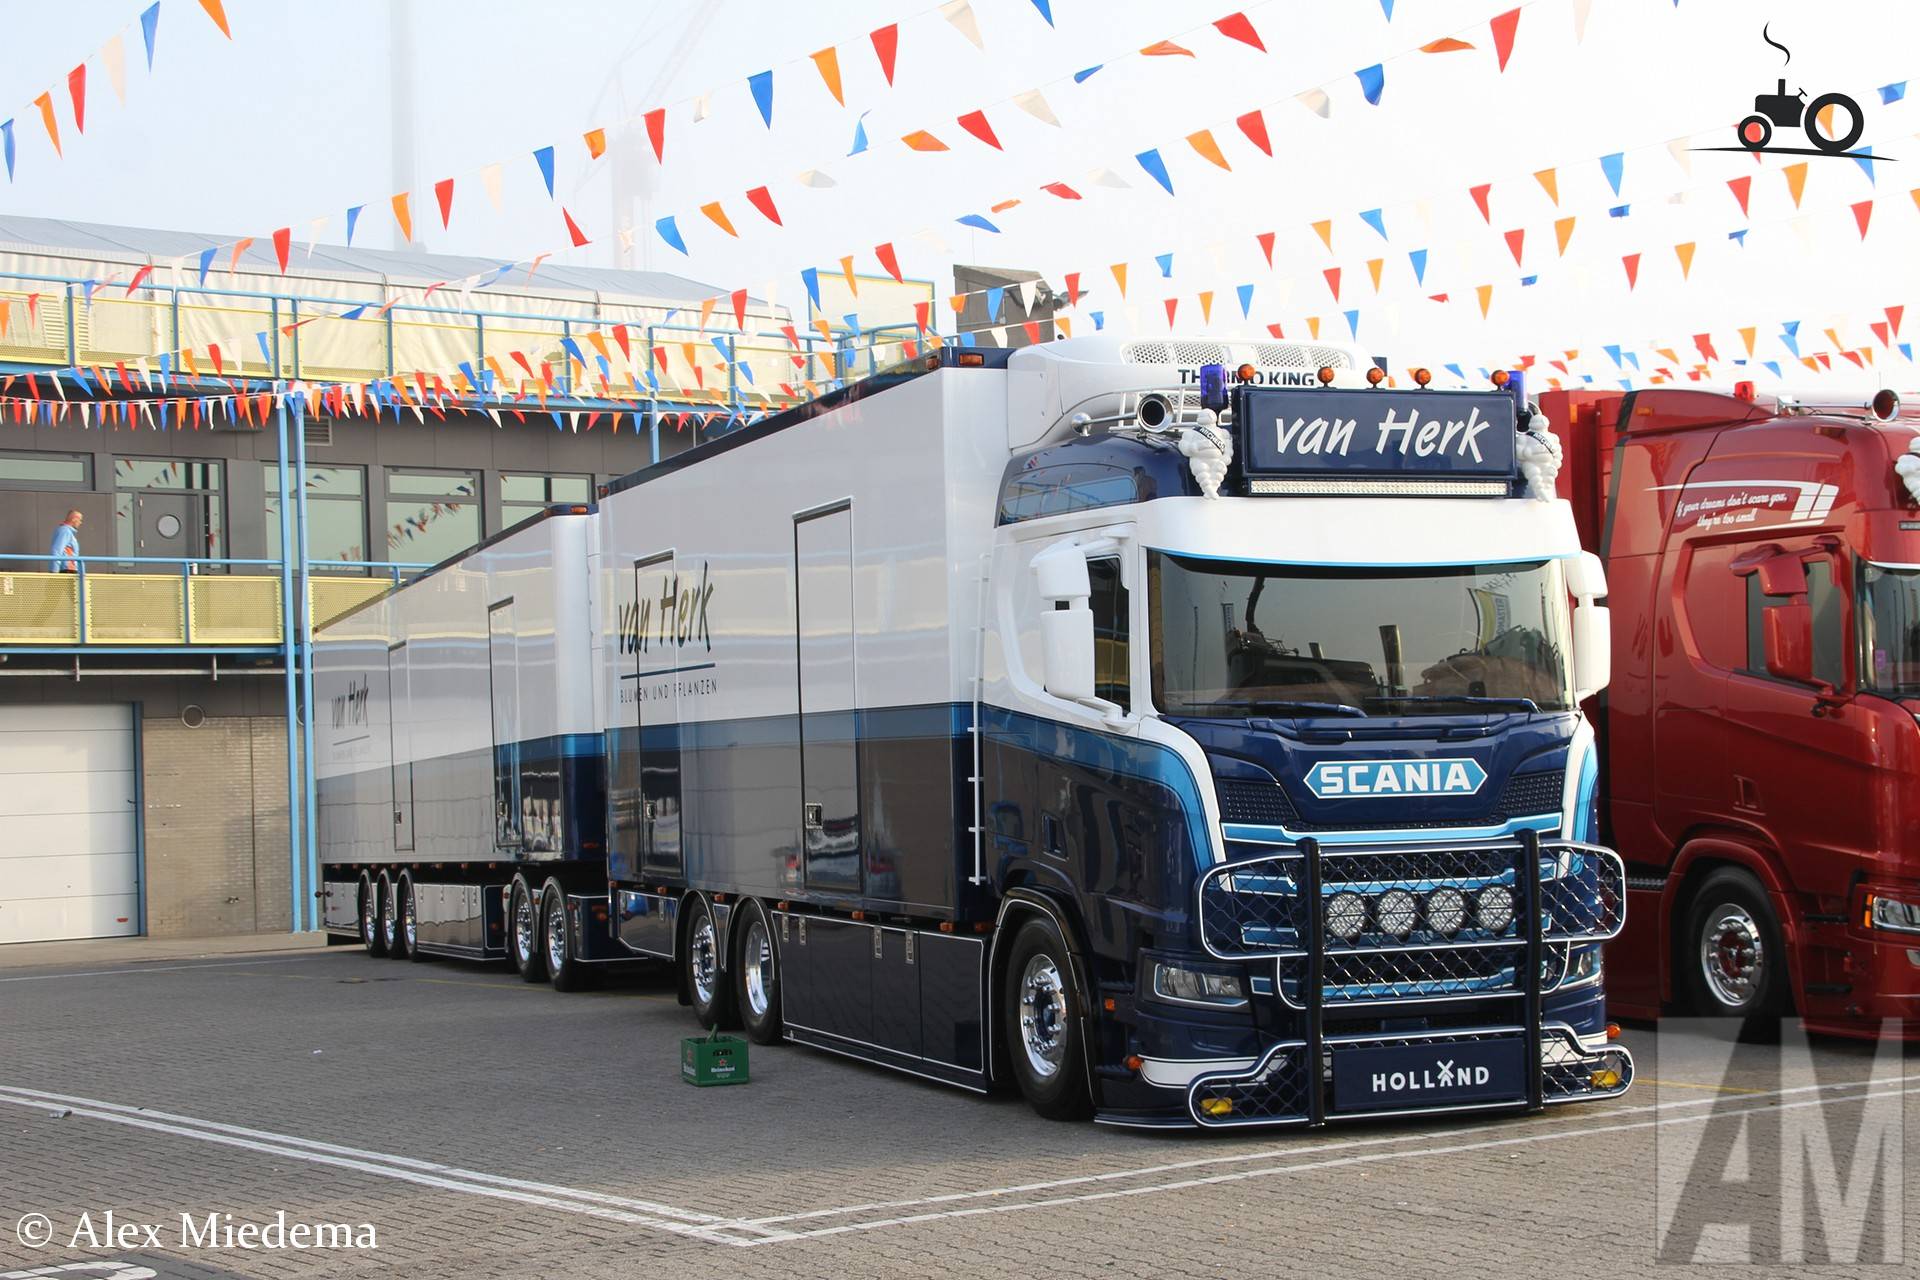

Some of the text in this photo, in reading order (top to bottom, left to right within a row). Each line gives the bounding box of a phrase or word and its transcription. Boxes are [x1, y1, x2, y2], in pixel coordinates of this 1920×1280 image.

[1268, 371, 1315, 386] KING
[1275, 406, 1490, 464] van Herk
[1722, 513, 1735, 525] too
[619, 560, 714, 655] van Herk
[652, 684, 669, 700] UND
[673, 678, 718, 697] PFLANZEN
[1320, 762, 1473, 794] SCANIA
[1372, 1060, 1490, 1092] HOLLAND
